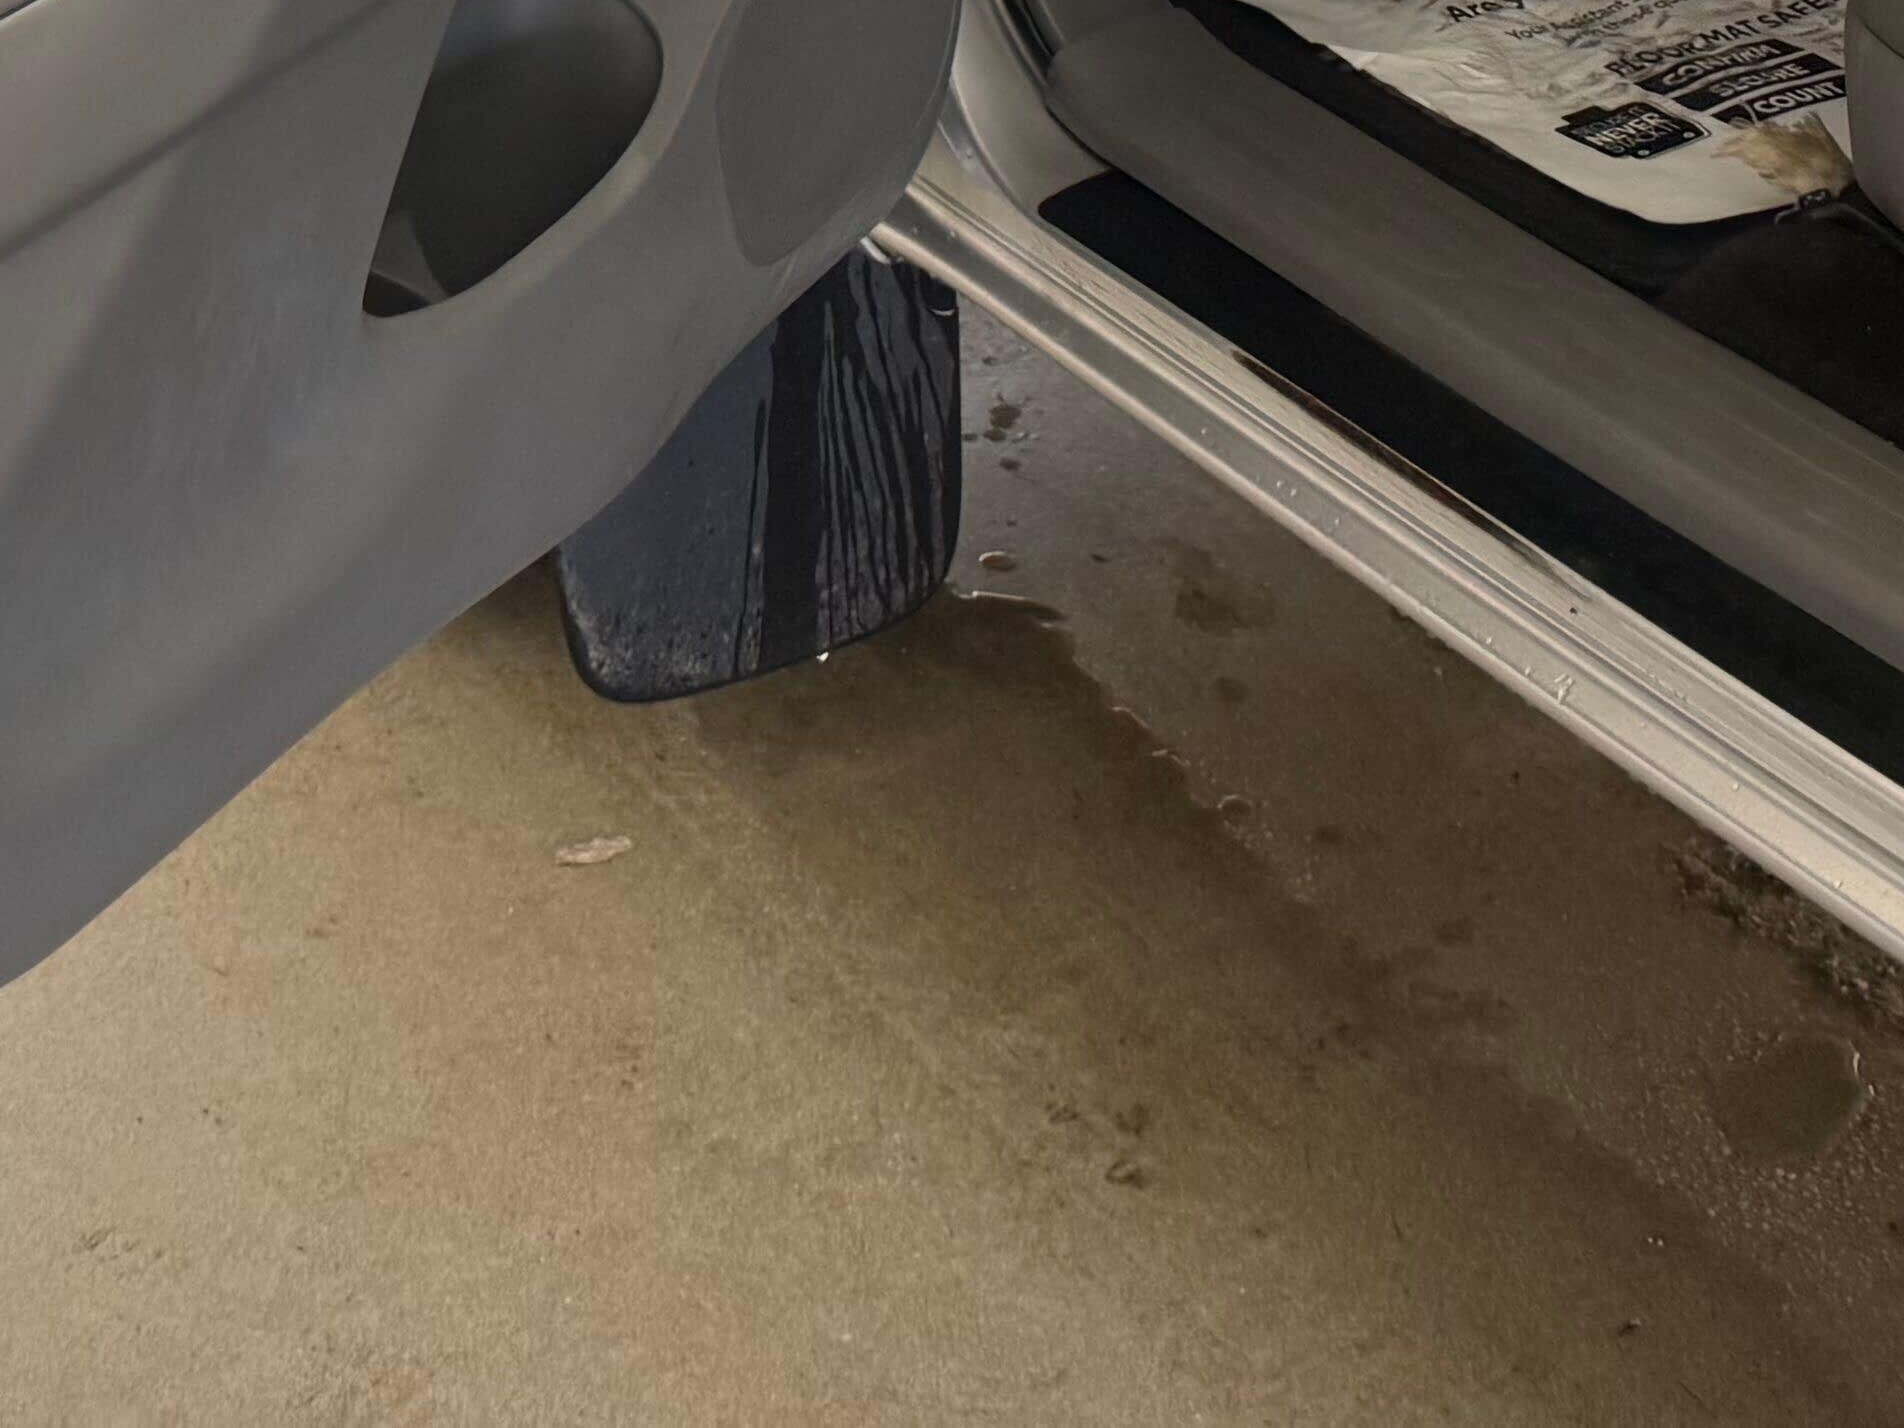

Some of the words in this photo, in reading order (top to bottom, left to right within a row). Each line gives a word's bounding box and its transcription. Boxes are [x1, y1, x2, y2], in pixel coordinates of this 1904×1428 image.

[1702, 20, 1761, 48] MAT
[1753, 80, 1846, 114] COUNT
[1585, 112, 1665, 145] NEVER
